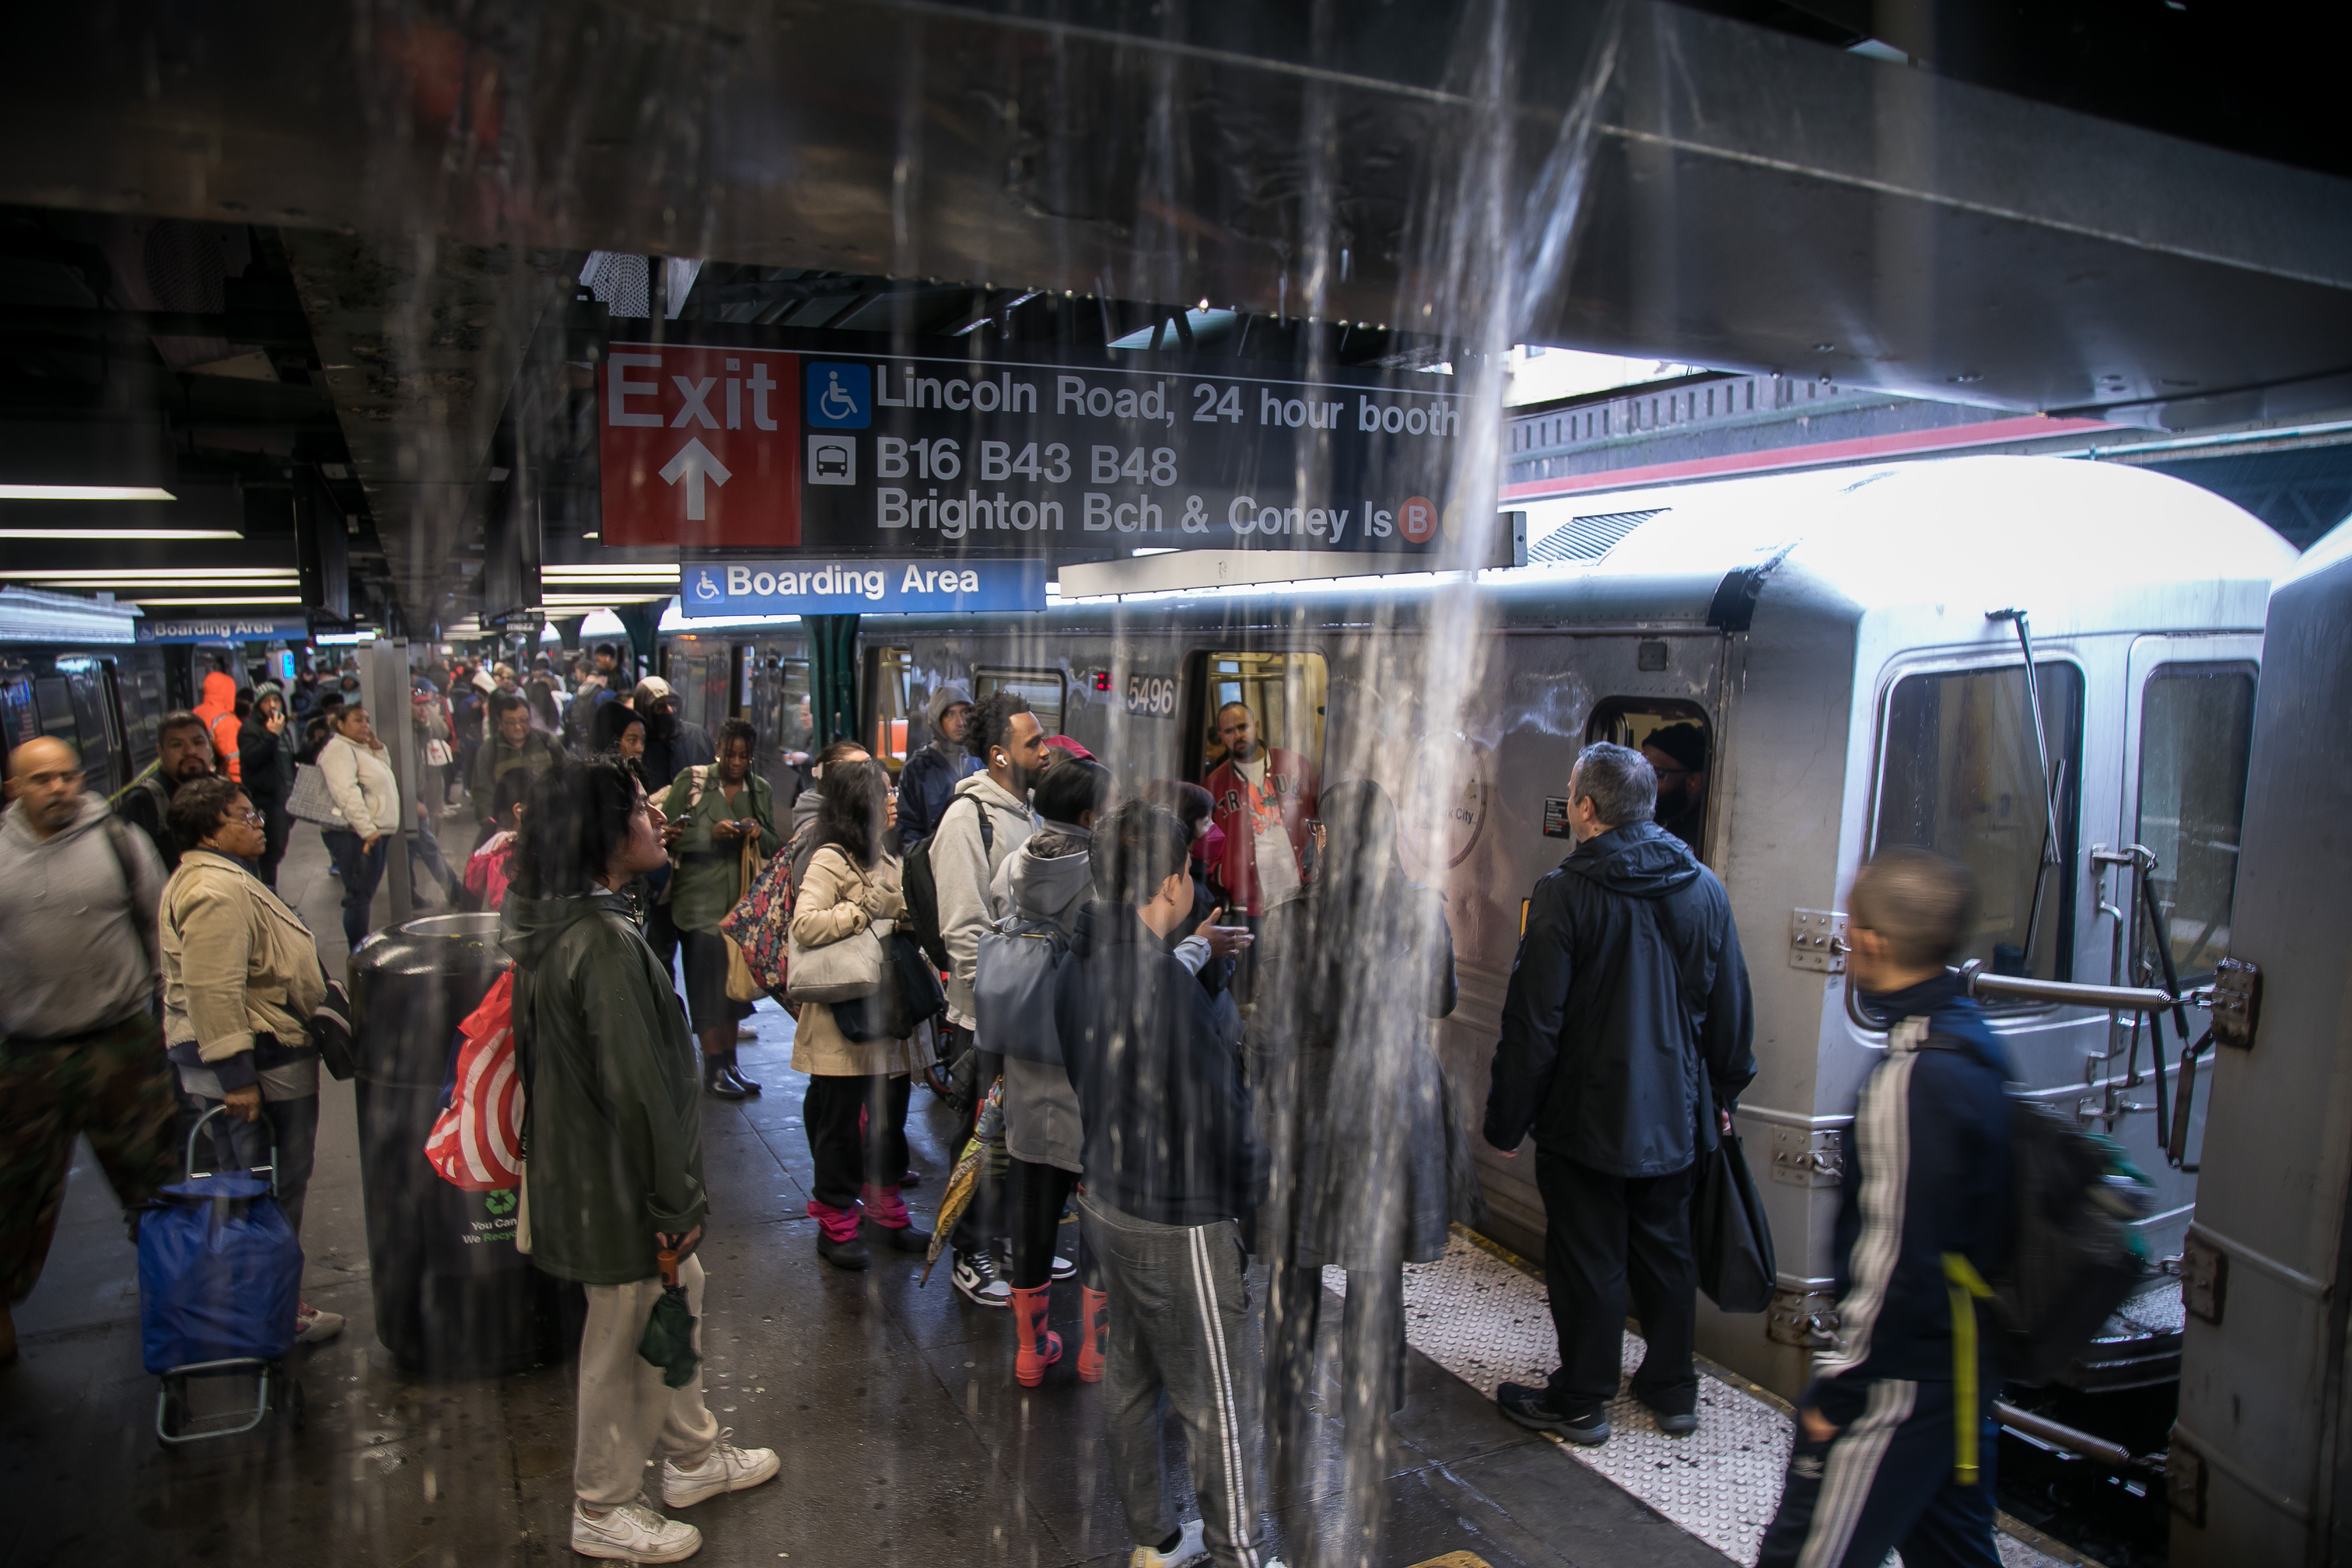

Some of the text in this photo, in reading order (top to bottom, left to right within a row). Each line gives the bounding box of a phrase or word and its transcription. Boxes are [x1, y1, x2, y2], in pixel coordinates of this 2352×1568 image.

[608, 353, 777, 431] Exit
[877, 365, 1460, 437] Lincoln Road, 24 hour booth
[877, 436, 1178, 486] B16 B43 B48
[877, 488, 1064, 539] Brighton
[1084, 492, 1162, 532] Bch
[1182, 495, 1209, 534] &
[1228, 496, 1349, 544] Coney
[1365, 501, 1392, 537] Is
[1408, 505, 1428, 534] B
[728, 564, 979, 600] Boarding Area
[155, 621, 273, 638] Boarding Area
[1128, 677, 1174, 714] 5496
[1456, 807, 1474, 825] City
[462, 1234, 481, 1244] We
[470, 1218, 518, 1231] You Can
